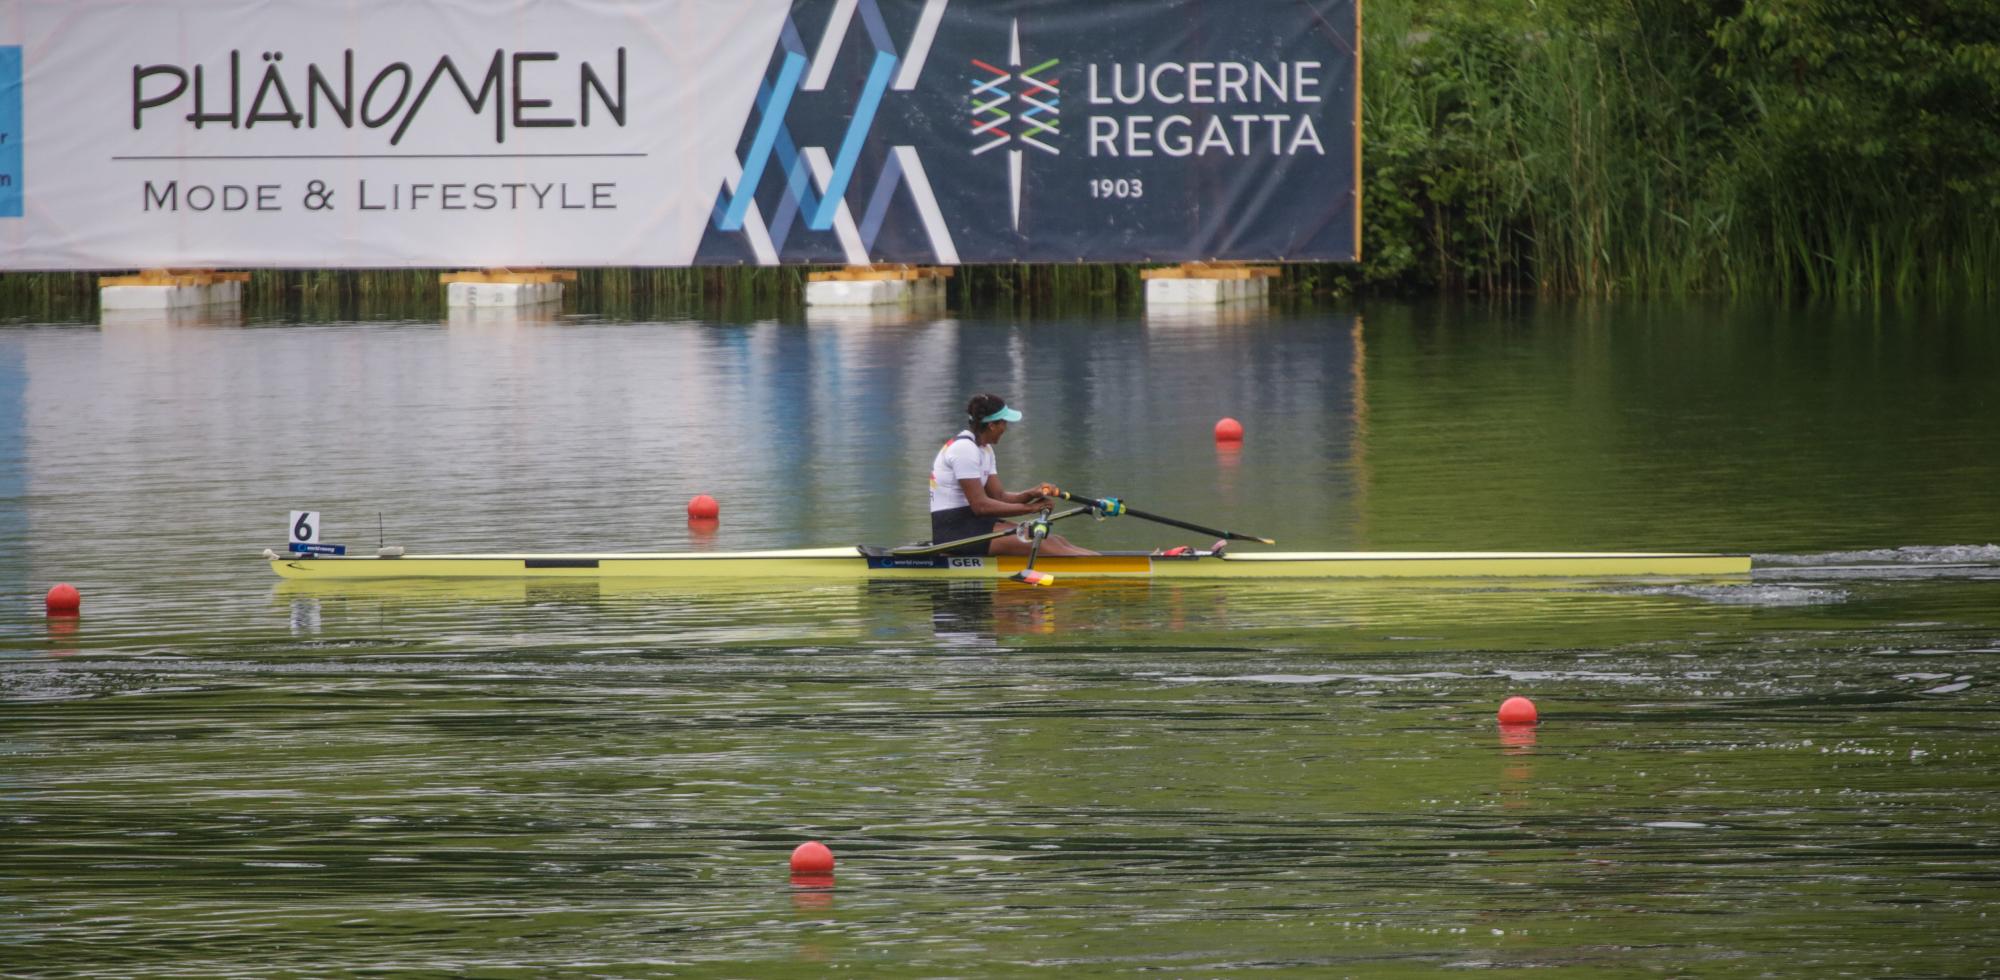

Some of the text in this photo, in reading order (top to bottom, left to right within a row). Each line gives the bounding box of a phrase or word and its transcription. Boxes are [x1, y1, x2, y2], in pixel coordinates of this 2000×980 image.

[133, 47, 627, 146] PHÄNOMEN
[1089, 61, 1322, 104] LUCERNE
[1089, 114, 1326, 156] REGATTA
[303, 179, 335, 212] &
[1090, 179, 1143, 199] 1903
[294, 512, 313, 542] 6
[952, 558, 981, 567] GER
